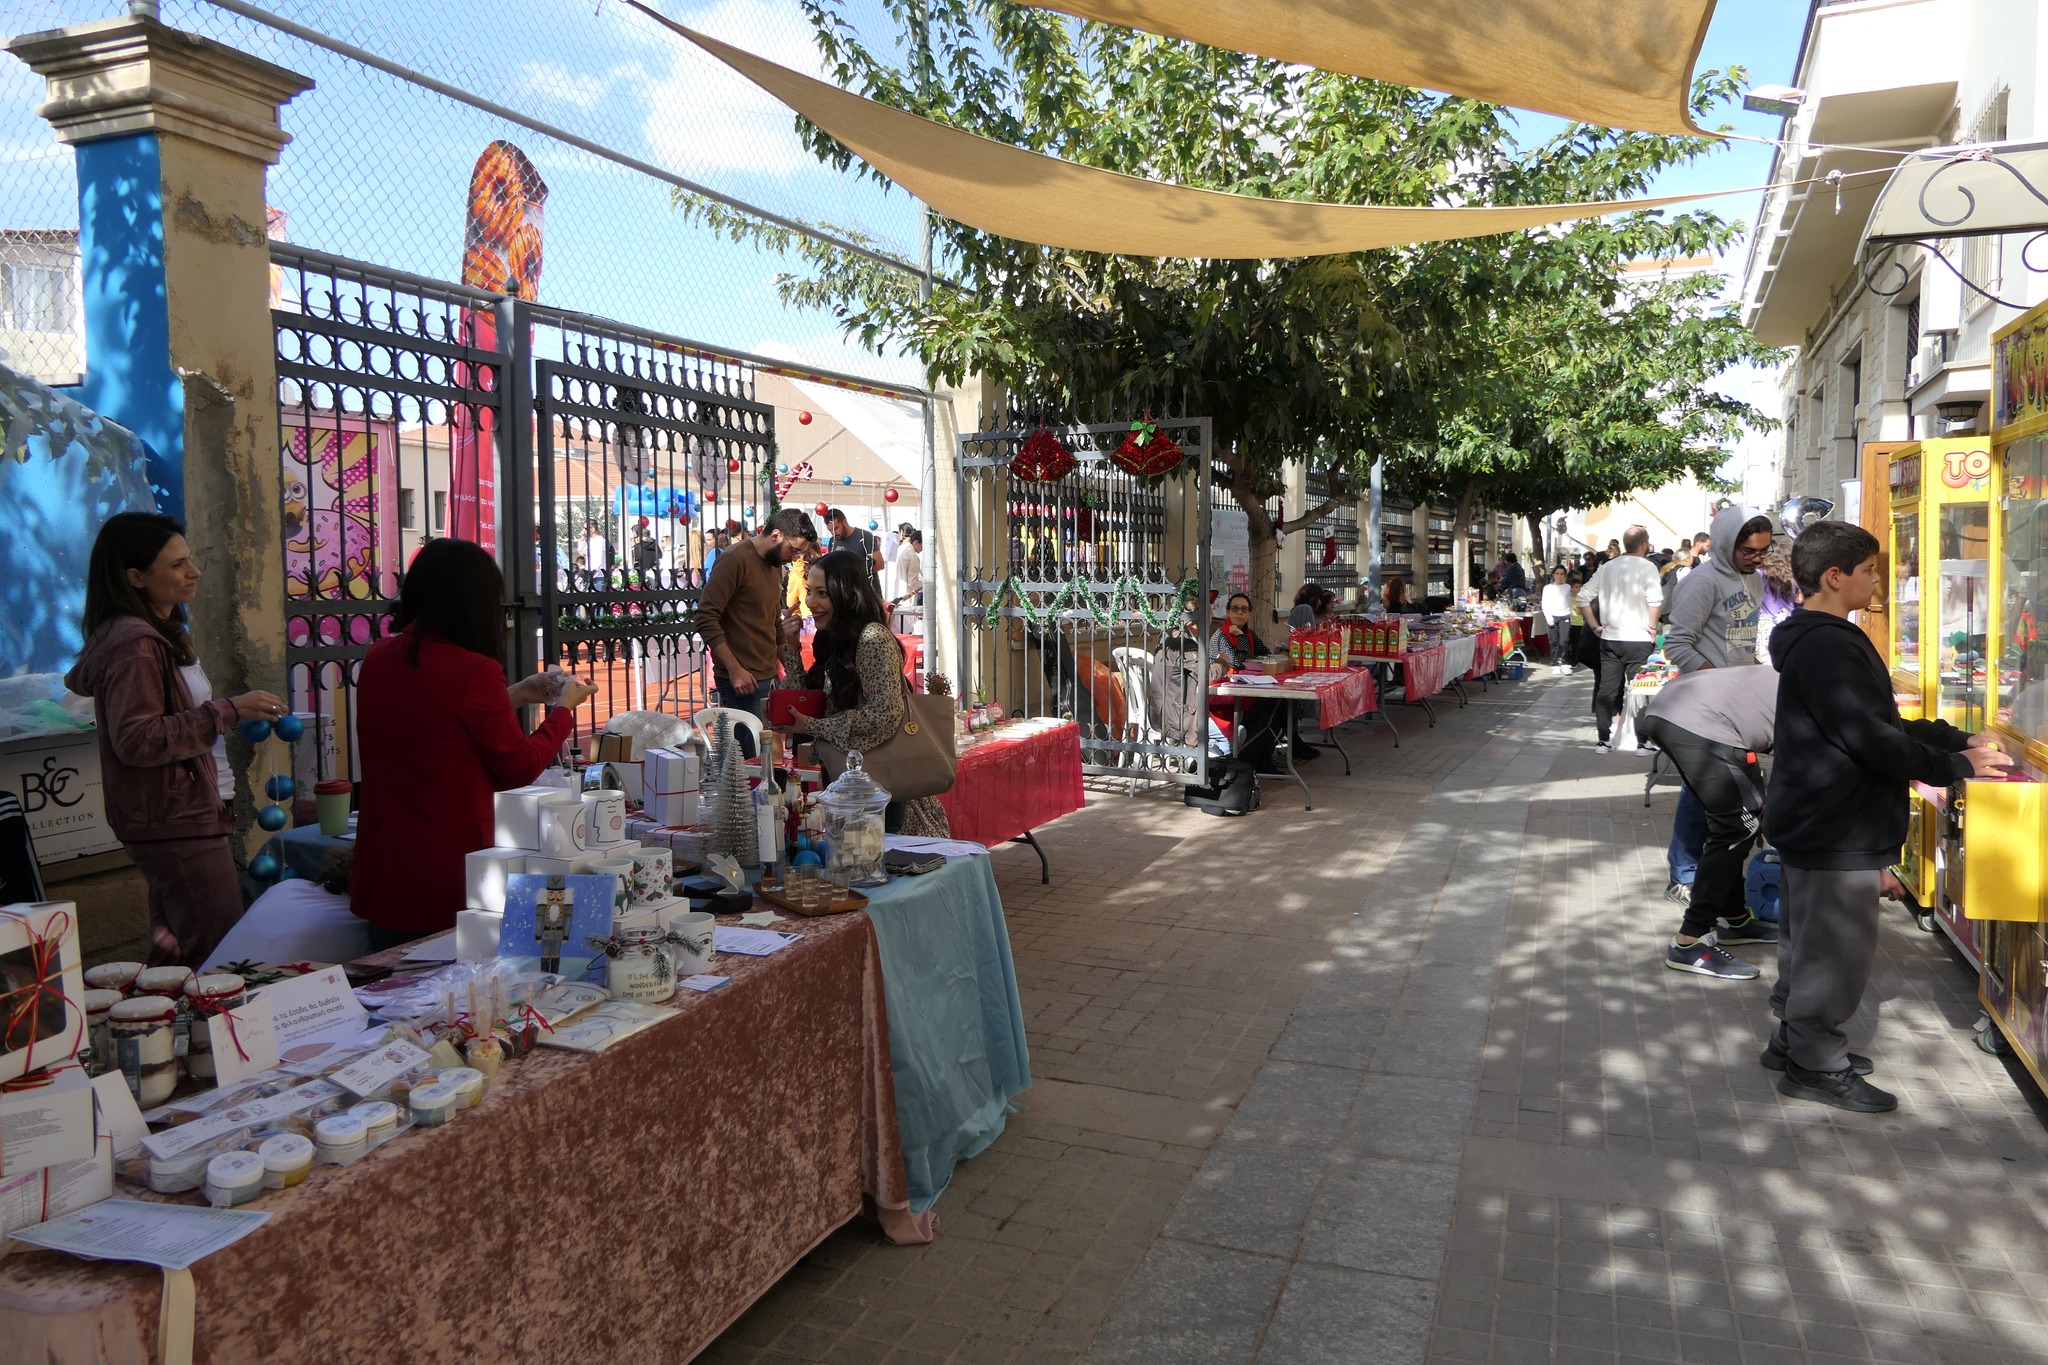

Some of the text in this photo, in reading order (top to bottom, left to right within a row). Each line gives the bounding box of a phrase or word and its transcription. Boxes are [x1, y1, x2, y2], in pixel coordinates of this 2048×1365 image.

[32, 812, 95, 830] LLECTION
[635, 990, 643, 998] OF
[645, 989, 656, 997] THE
